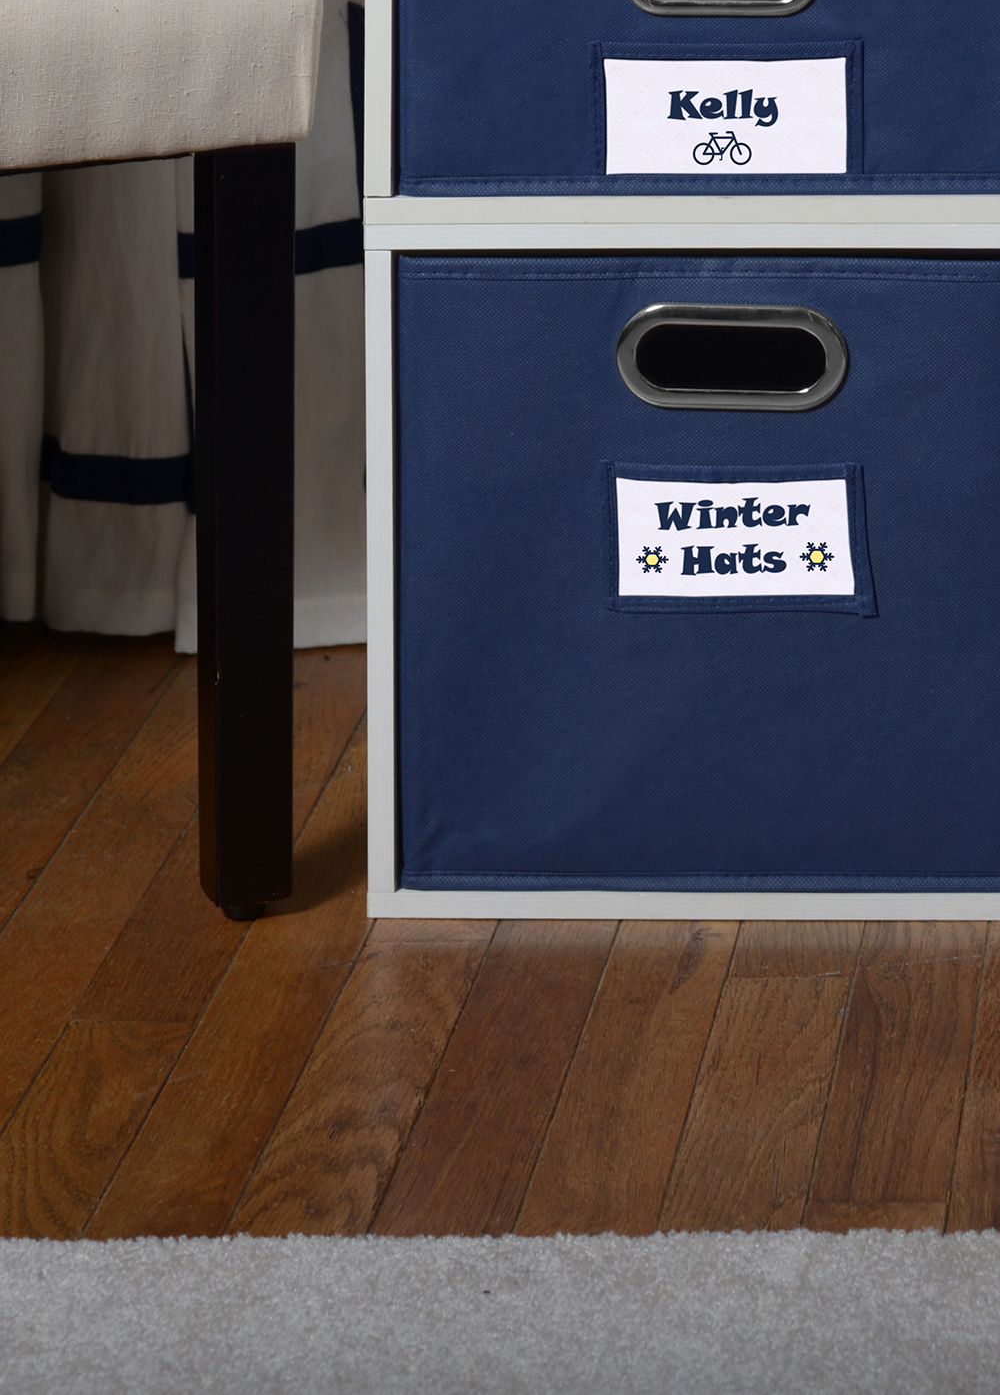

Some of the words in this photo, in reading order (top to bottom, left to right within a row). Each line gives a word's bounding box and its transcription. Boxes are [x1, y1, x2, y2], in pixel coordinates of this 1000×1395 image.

[667, 89, 779, 127] Kelly
[654, 497, 811, 531] Winter
[680, 543, 787, 576] Hats
